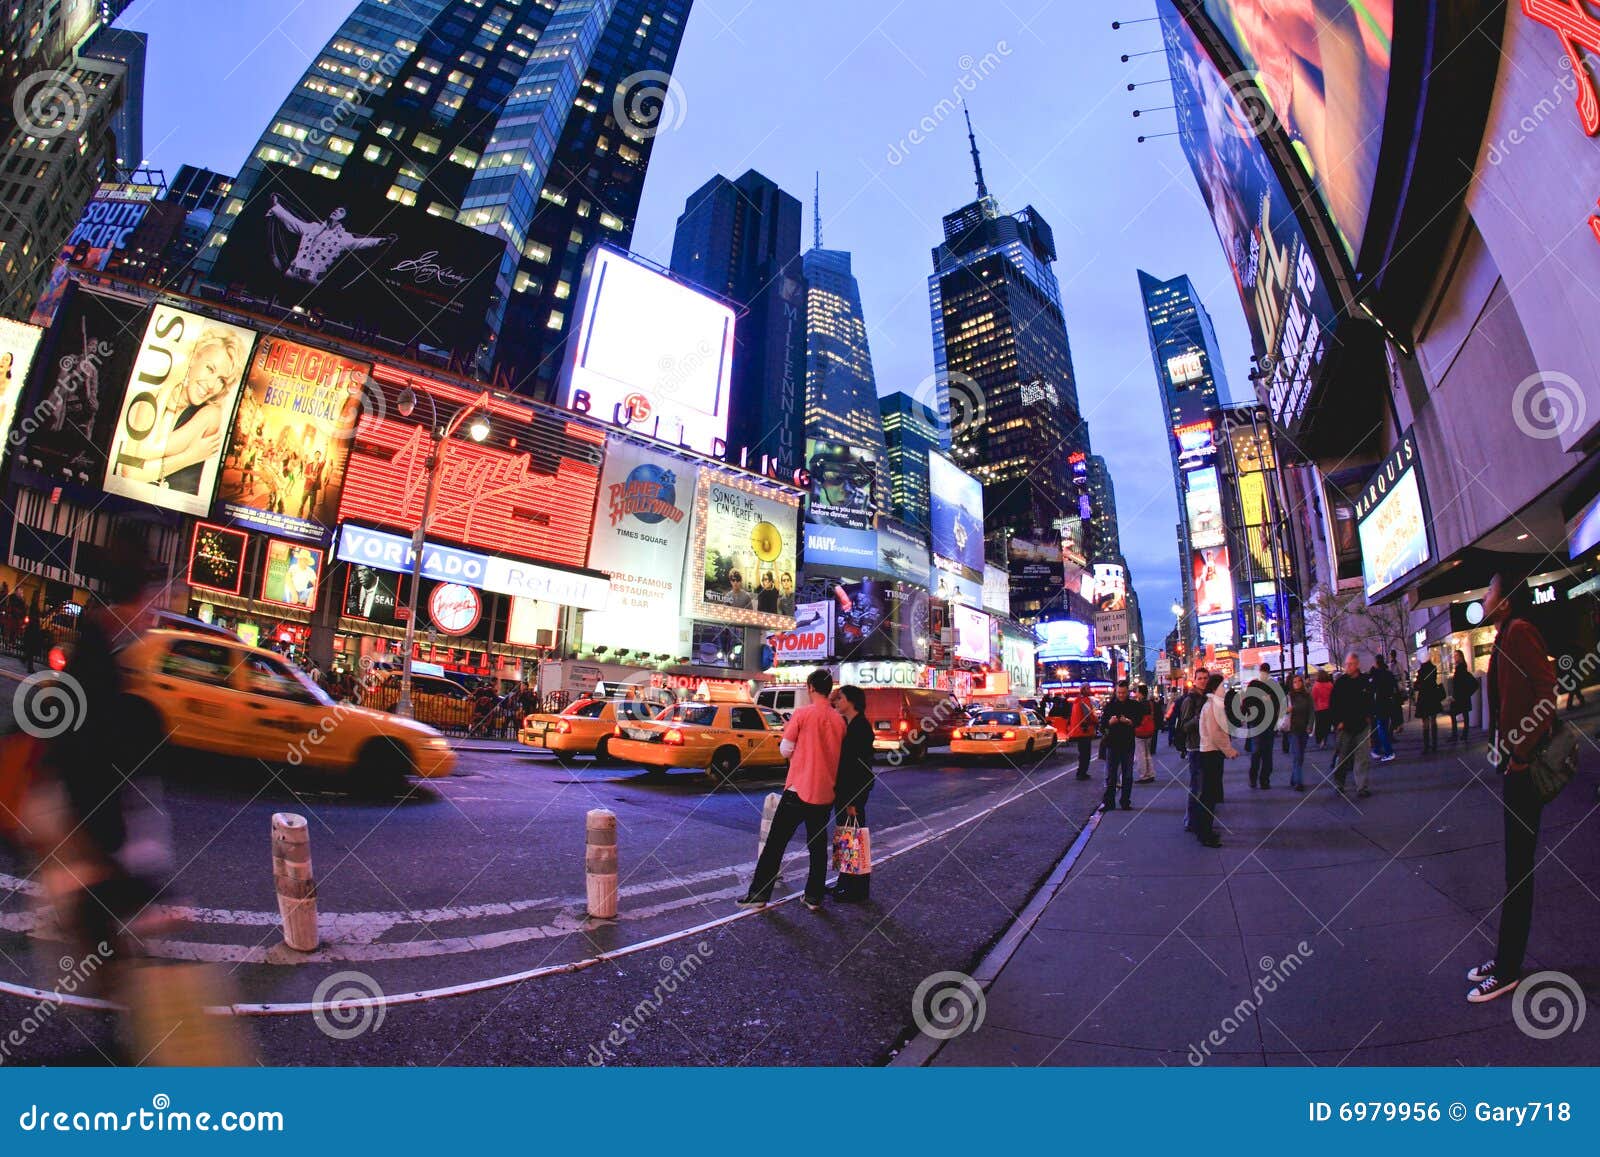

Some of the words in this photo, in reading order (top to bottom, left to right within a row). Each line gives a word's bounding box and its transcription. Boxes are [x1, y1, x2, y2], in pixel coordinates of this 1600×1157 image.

[81, 202, 148, 227] SOUTH
[68, 222, 134, 249] PACIFIC
[1255, 194, 1289, 354] UFC
[1296, 243, 1316, 307] 15
[263, 340, 364, 395] HEIGHTS
[113, 313, 186, 476] TOUS
[291, 381, 310, 393] TONY
[778, 302, 798, 466] MILLENNIUM
[264, 386, 290, 408] BEST
[292, 393, 337, 420] MUSICAL
[573, 388, 810, 487] BUILDING
[392, 425, 556, 543] Virgin
[1355, 439, 1412, 519] MARQUIS
[608, 480, 663, 509] PLANET
[712, 487, 741, 506] SONGS
[744, 498, 754, 511] WE
[609, 495, 685, 527] HOLLYWOOD
[716, 502, 730, 514] CAN
[731, 505, 752, 521] AGREE
[811, 508, 829, 516] before
[616, 528, 639, 540] TIMES
[640, 534, 668, 546] SQUARE
[344, 531, 482, 579] VORNADO
[375, 595, 395, 607] SEAL
[631, 597, 649, 608] BAR
[1103, 623, 1120, 632] MUST
[1112, 613, 1126, 621] LANE
[767, 631, 826, 652] STOMP
